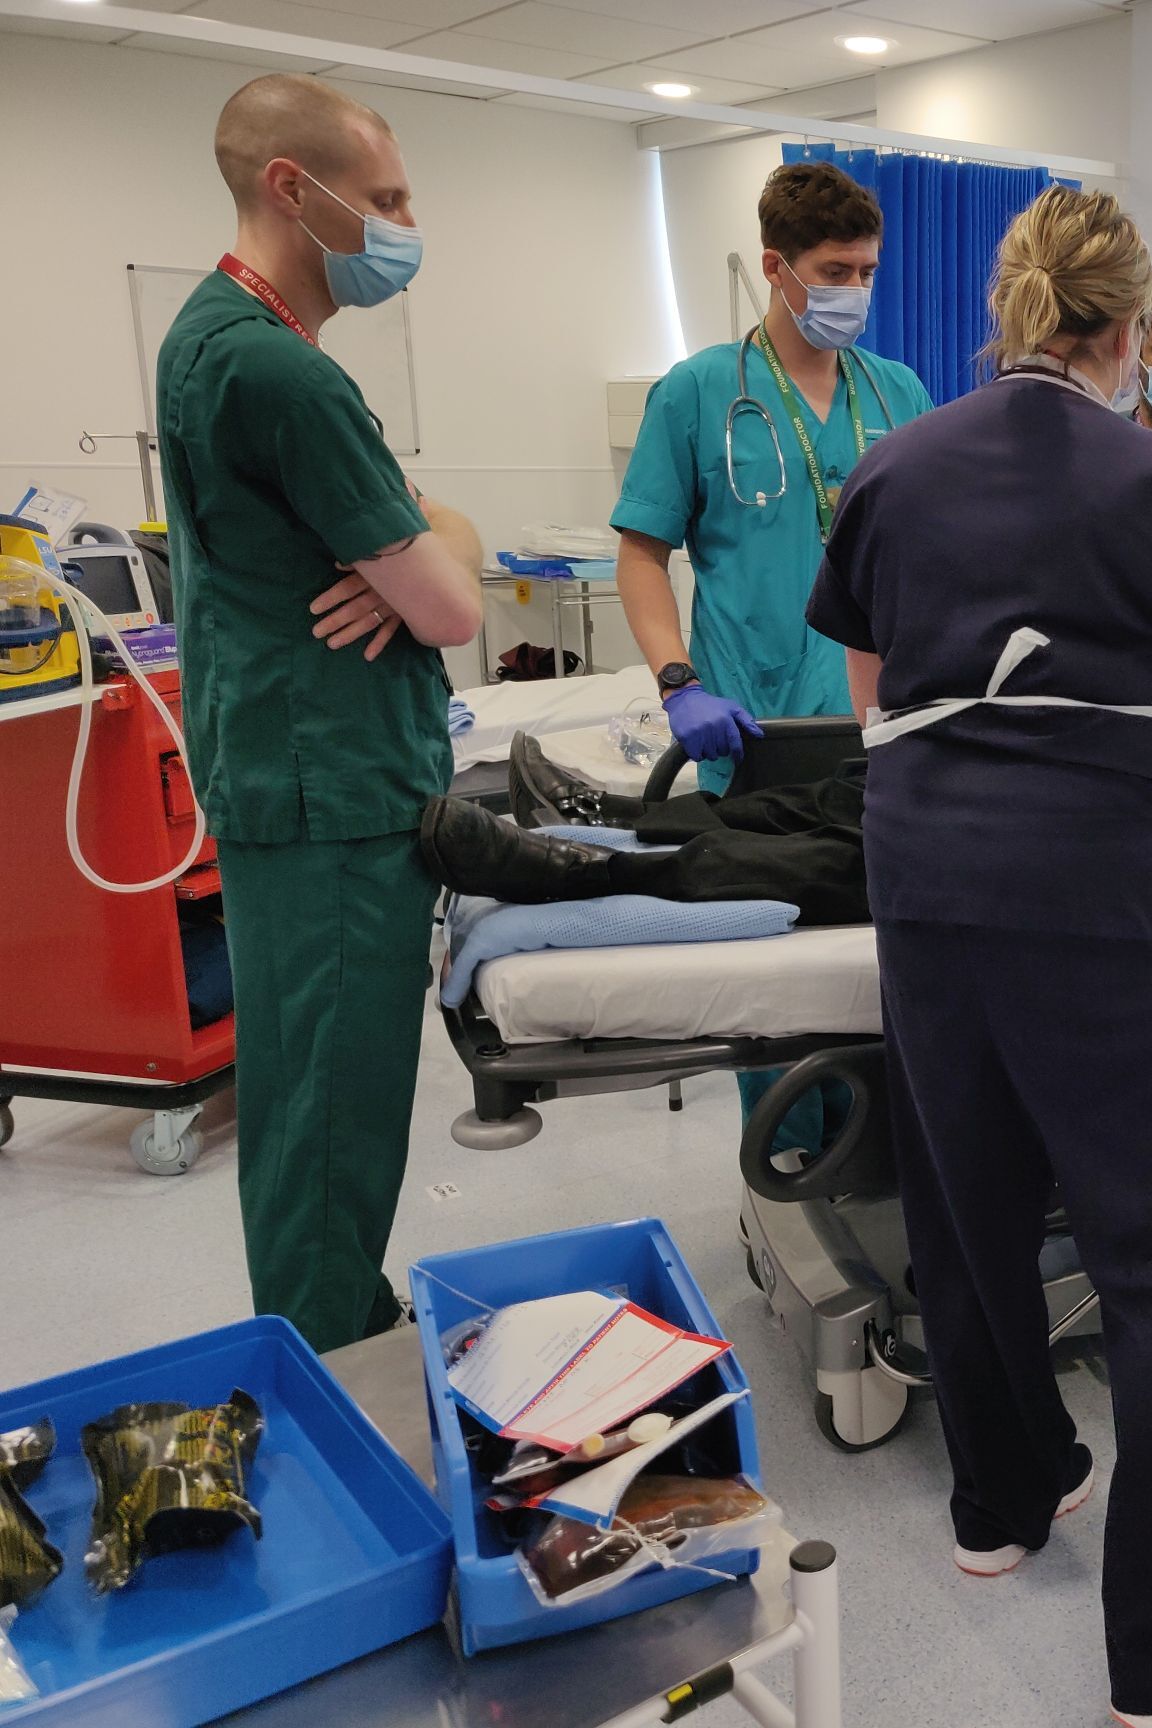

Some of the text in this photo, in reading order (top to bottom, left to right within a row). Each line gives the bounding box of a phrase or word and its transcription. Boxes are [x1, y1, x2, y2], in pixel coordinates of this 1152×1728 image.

[239, 268, 296, 323] SPECIALIST
[763, 342, 789, 393] FOUNDATION
[793, 416, 828, 510] FOUNDATION DOCTOR
[854, 418, 865, 458] FOUNDA
[569, 1350, 587, 1369] LABEL
[585, 1342, 595, 1353] TO
[591, 1322, 613, 1346] PATIENT
[610, 1307, 628, 1325] NOTES
